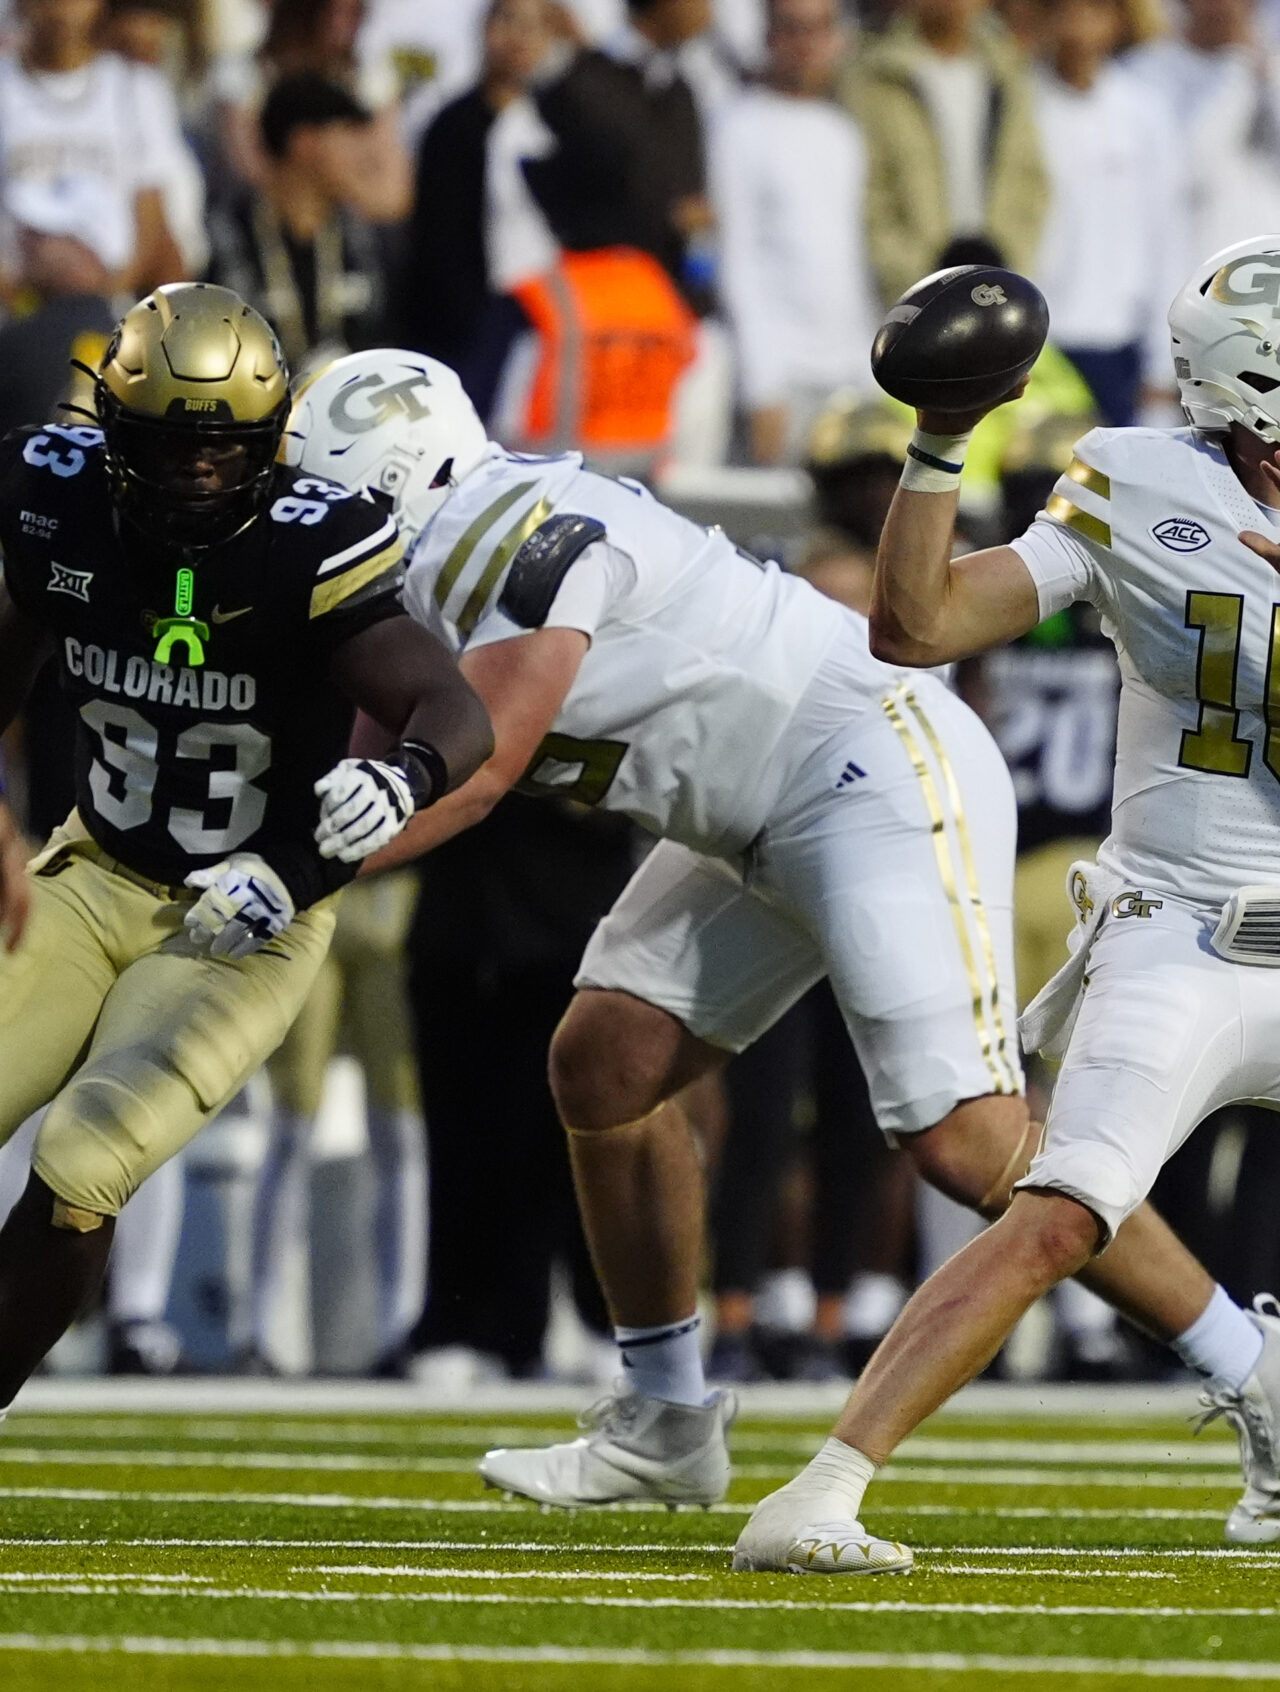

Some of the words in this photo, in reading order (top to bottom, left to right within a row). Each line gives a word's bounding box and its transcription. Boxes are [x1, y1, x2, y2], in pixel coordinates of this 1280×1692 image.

[185, 399, 217, 411] BUFFS
[328, 373, 432, 434] GT
[20, 510, 58, 530] mac
[1161, 525, 1205, 542] ACC
[64, 636, 256, 711] COLORADO
[79, 698, 272, 855] 93
[1111, 890, 1163, 919] GT
